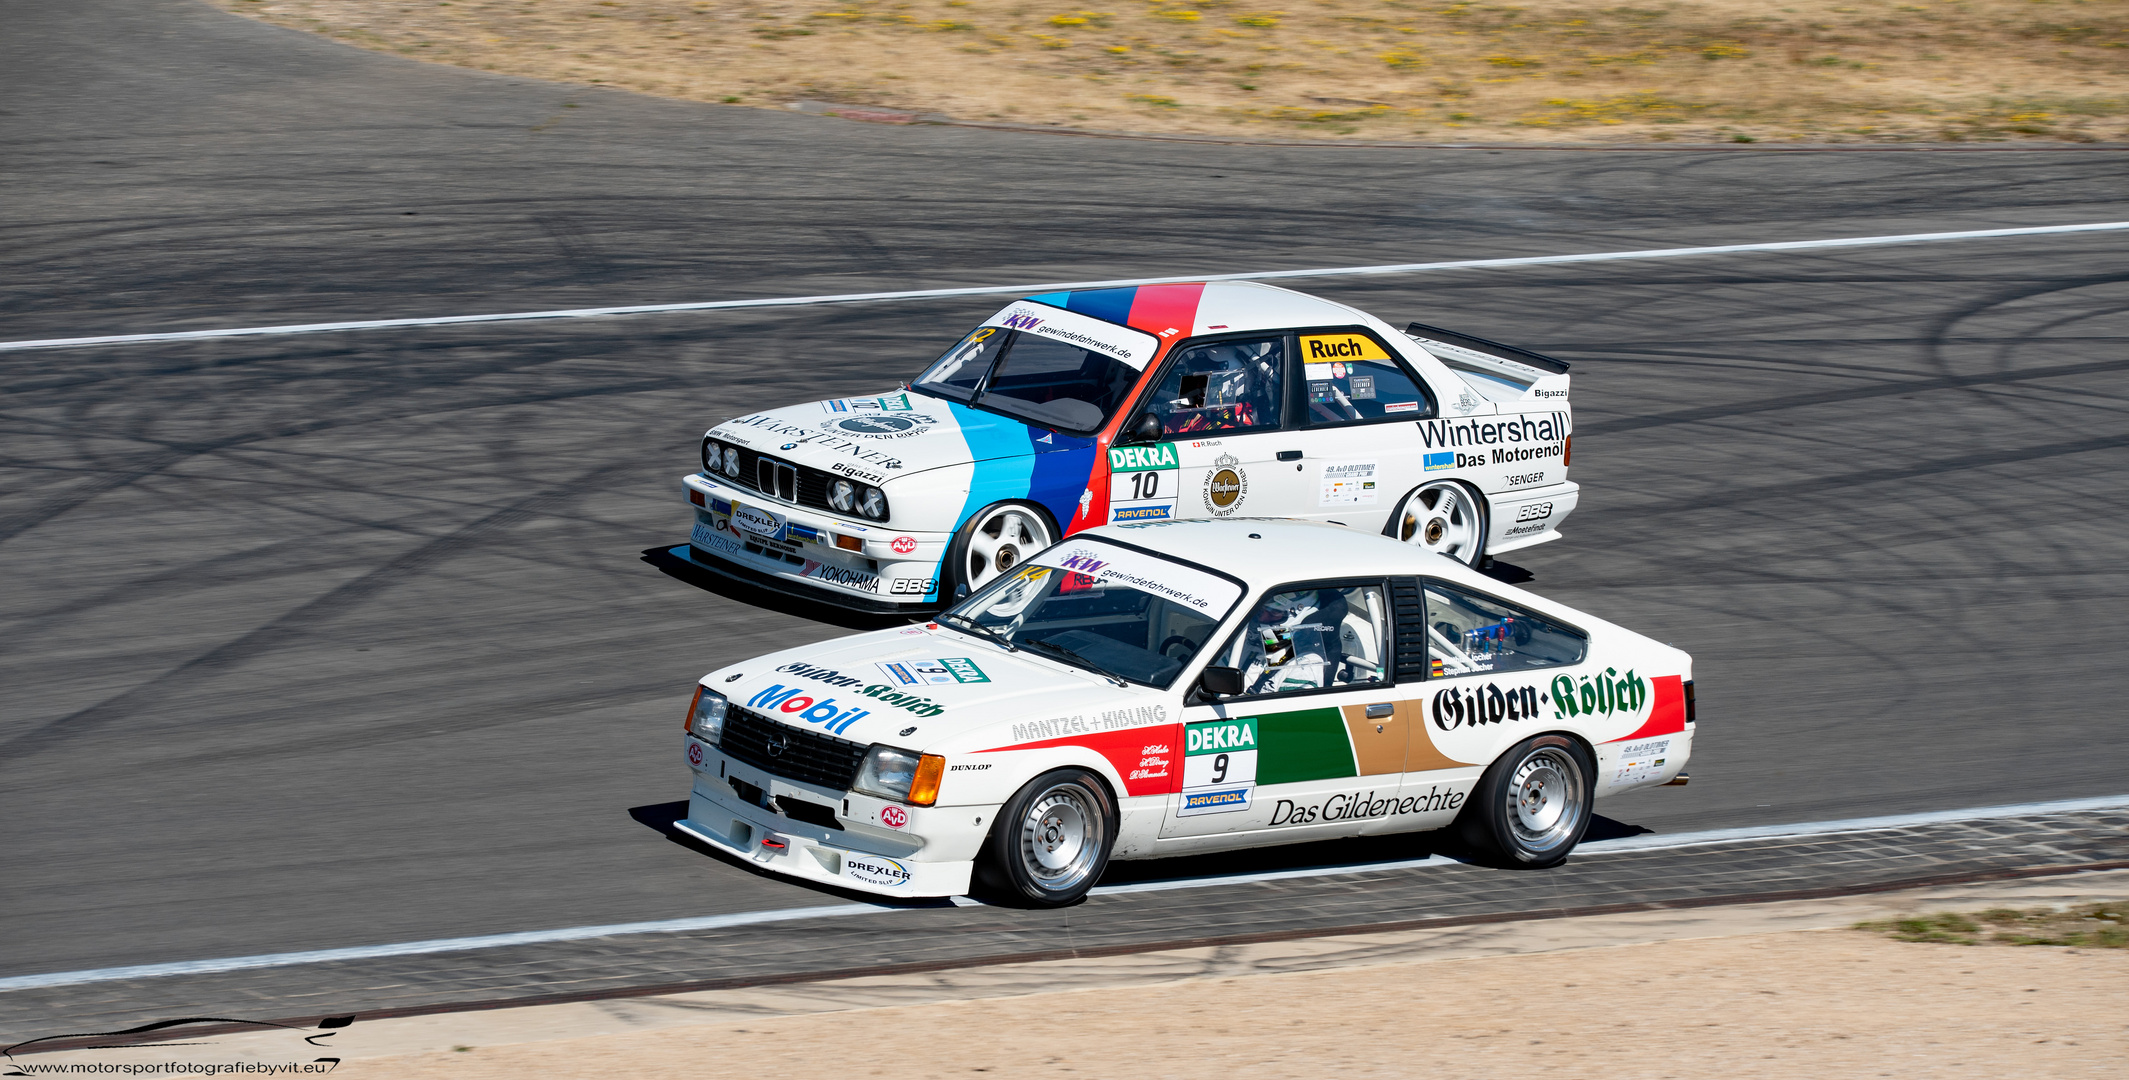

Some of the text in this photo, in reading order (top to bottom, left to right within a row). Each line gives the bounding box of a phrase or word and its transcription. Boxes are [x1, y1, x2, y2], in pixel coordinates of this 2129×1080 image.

[1001, 314, 1132, 359] KW gewindefahrwerk.de
[1309, 338, 1363, 358] Ruch
[1534, 390, 1568, 399] Bigazzi
[723, 433, 751, 446] Motorsport
[1416, 412, 1566, 448] Wintershall
[742, 414, 902, 469] WARSTEINER
[1110, 446, 1176, 469] DEKRA
[1456, 441, 1563, 468] Das Motorenöl
[831, 462, 883, 483] Bigazzi
[1425, 462, 1455, 471] wintershall
[1131, 471, 1159, 499] 10
[1203, 469, 1214, 486] EINE
[1238, 468, 1248, 495] BIEREN
[1509, 472, 1544, 486] SENGER
[1214, 508, 1235, 517] UNTER
[1234, 495, 1246, 510] DEN
[1516, 502, 1553, 523] BBS
[736, 510, 781, 529] DREXLER
[1117, 508, 1166, 519] RAVENOL
[691, 523, 741, 556] WARSTEINER
[892, 539, 916, 553] AvD
[820, 564, 879, 594] YOKOHAMA
[890, 578, 939, 594] BBS
[1060, 555, 1208, 608] KW gewindefahrwerk.de
[746, 684, 871, 736] Mobil
[1432, 681, 1539, 731] Gilden
[1012, 714, 1089, 742] MANTZEL
[1188, 723, 1255, 751] DEKRA
[950, 764, 992, 772] DUNLOP
[1211, 753, 1229, 783] 9
[1189, 793, 1242, 806] RAVENOL
[1268, 786, 1465, 826] Das Gildenechte
[882, 810, 907, 826] AvD
[848, 861, 912, 880] DREXLER
[851, 870, 878, 886] LIMITED
